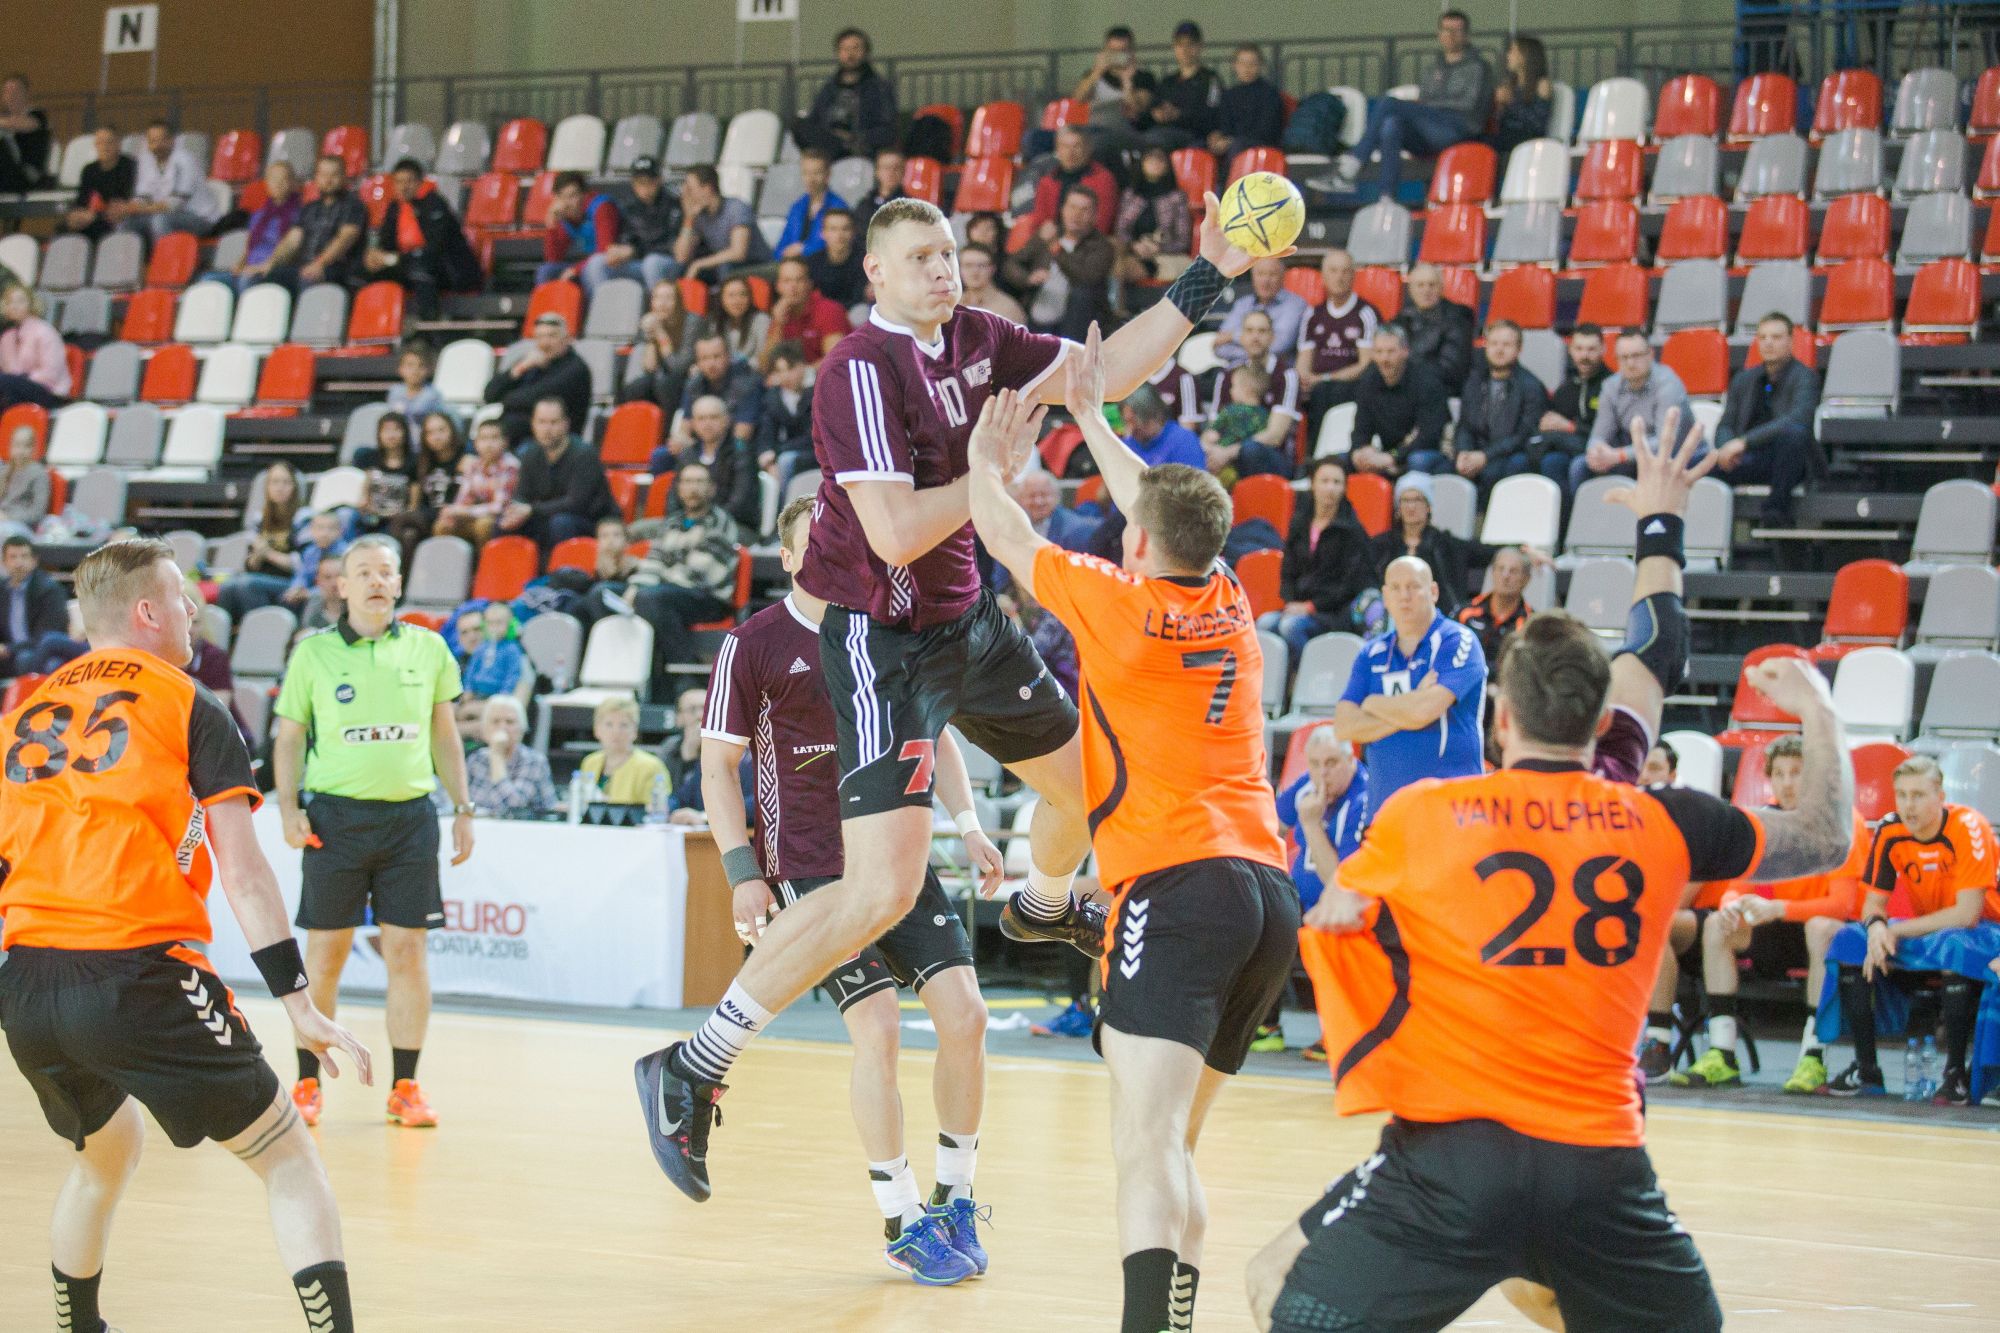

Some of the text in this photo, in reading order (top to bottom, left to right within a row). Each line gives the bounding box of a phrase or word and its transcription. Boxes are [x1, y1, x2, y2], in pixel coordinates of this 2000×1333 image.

[119, 12, 143, 45] N
[935, 376, 968, 428] 10
[1941, 420, 1952, 439] 7
[1181, 648, 1237, 726] 7
[5, 690, 141, 784] 85
[793, 743, 838, 755] LATVIJA
[898, 739, 935, 795] 7
[1452, 797, 1644, 833] VAN OLPHEN
[443, 900, 527, 938] EURO
[1474, 851, 1645, 968] 28
[488, 939, 530, 961] 2018
[724, 999, 757, 1029] NIKE
